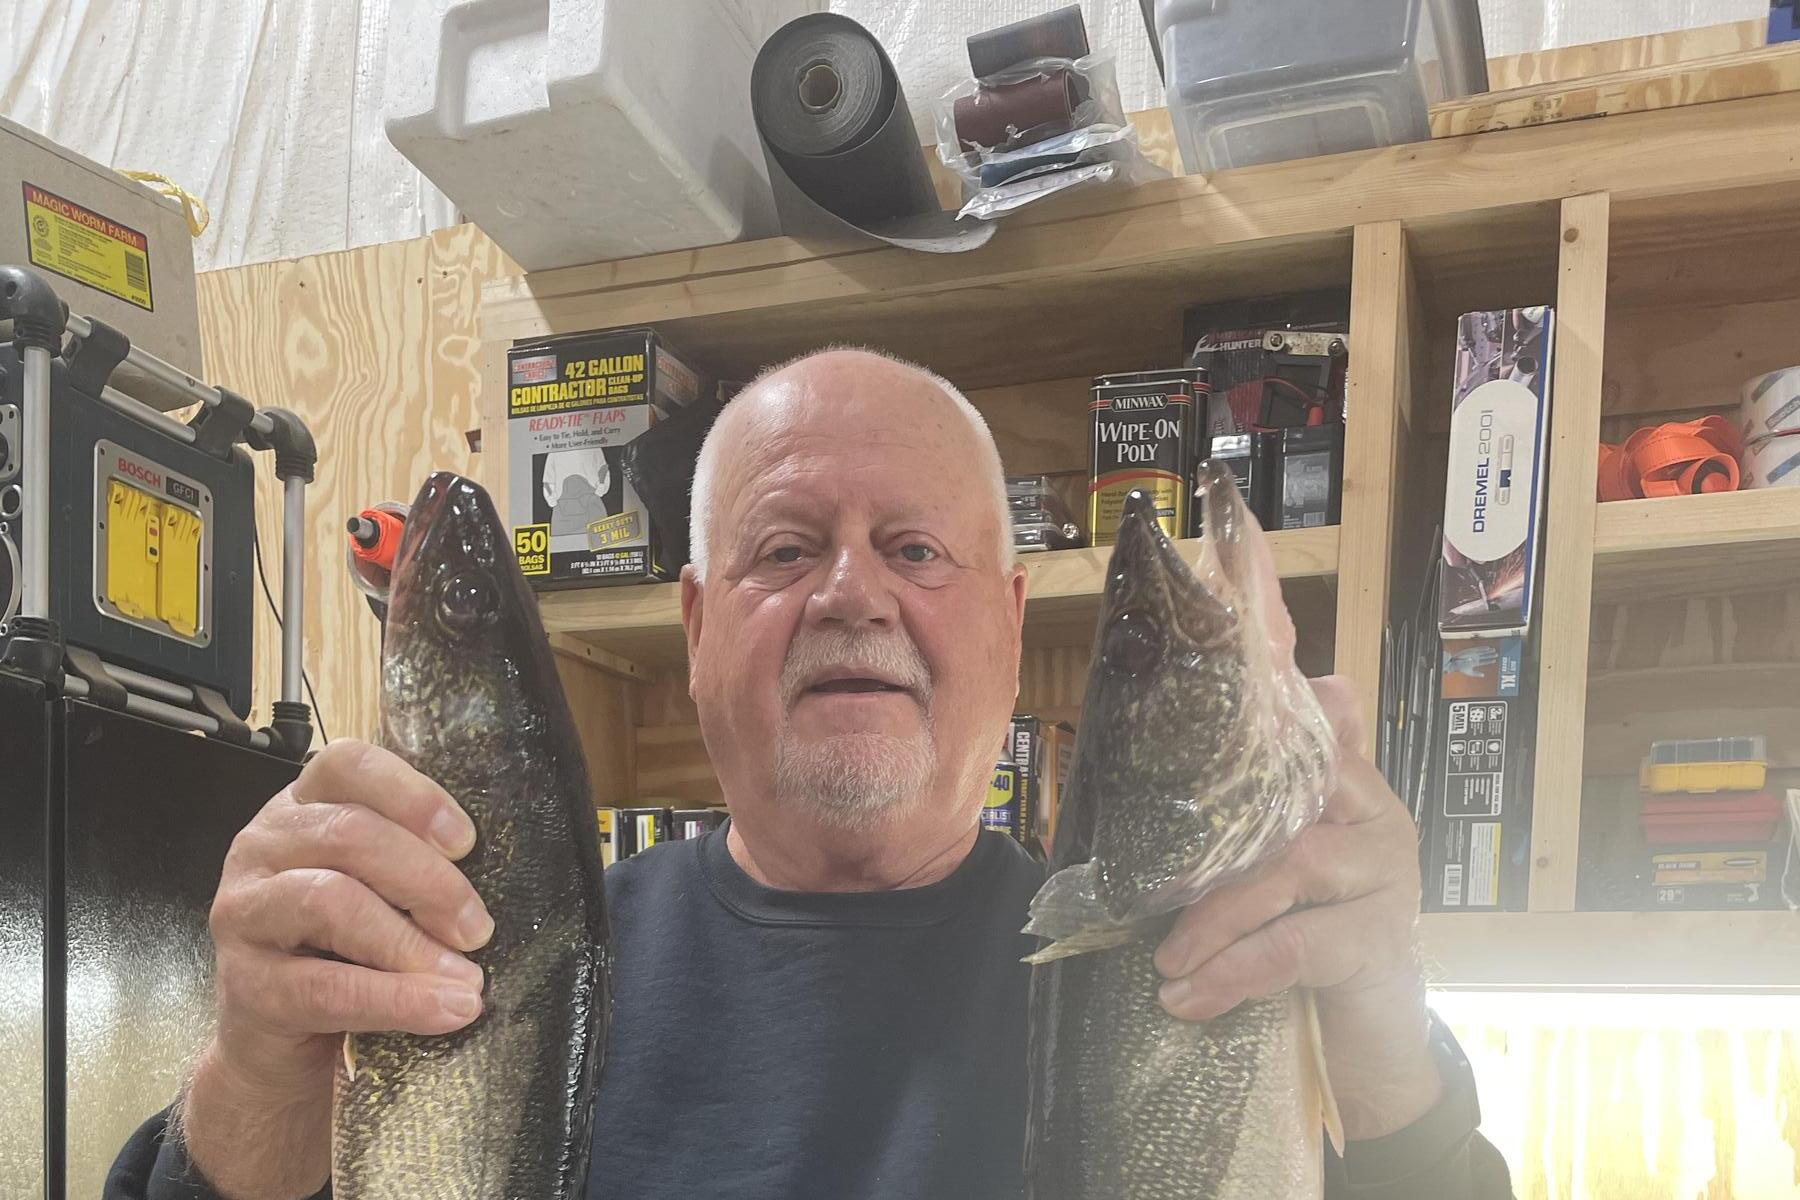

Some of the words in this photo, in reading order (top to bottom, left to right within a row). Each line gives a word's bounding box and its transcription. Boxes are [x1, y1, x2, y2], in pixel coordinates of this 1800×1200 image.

[33, 191, 70, 216] MAGIC
[71, 208, 106, 233] WORM
[108, 224, 137, 246] FARM
[1220, 339, 1261, 351] HUNTER
[565, 361, 586, 379] 42
[588, 354, 643, 377] GALLON
[608, 374, 643, 385] CLEAN-UP
[511, 378, 607, 406] CONTRACTOR
[608, 385, 628, 395] BAGS
[1115, 396, 1163, 410] MINWAX
[592, 409, 626, 425] FLAPS
[1100, 419, 1180, 442] WIPE-ON
[1117, 443, 1158, 463] POLY
[118, 457, 161, 487] BOSCH
[172, 482, 194, 500] GFCI
[1473, 457, 1490, 533] DREMEL
[517, 531, 546, 553] 50
[601, 534, 608, 545] 3
[610, 527, 630, 541] MIL
[519, 555, 545, 565] BAGS
[1501, 675, 1516, 690] XL
[1453, 713, 1465, 731] MIL
[990, 775, 1009, 791] -40
[981, 810, 1011, 821] CIALIST
